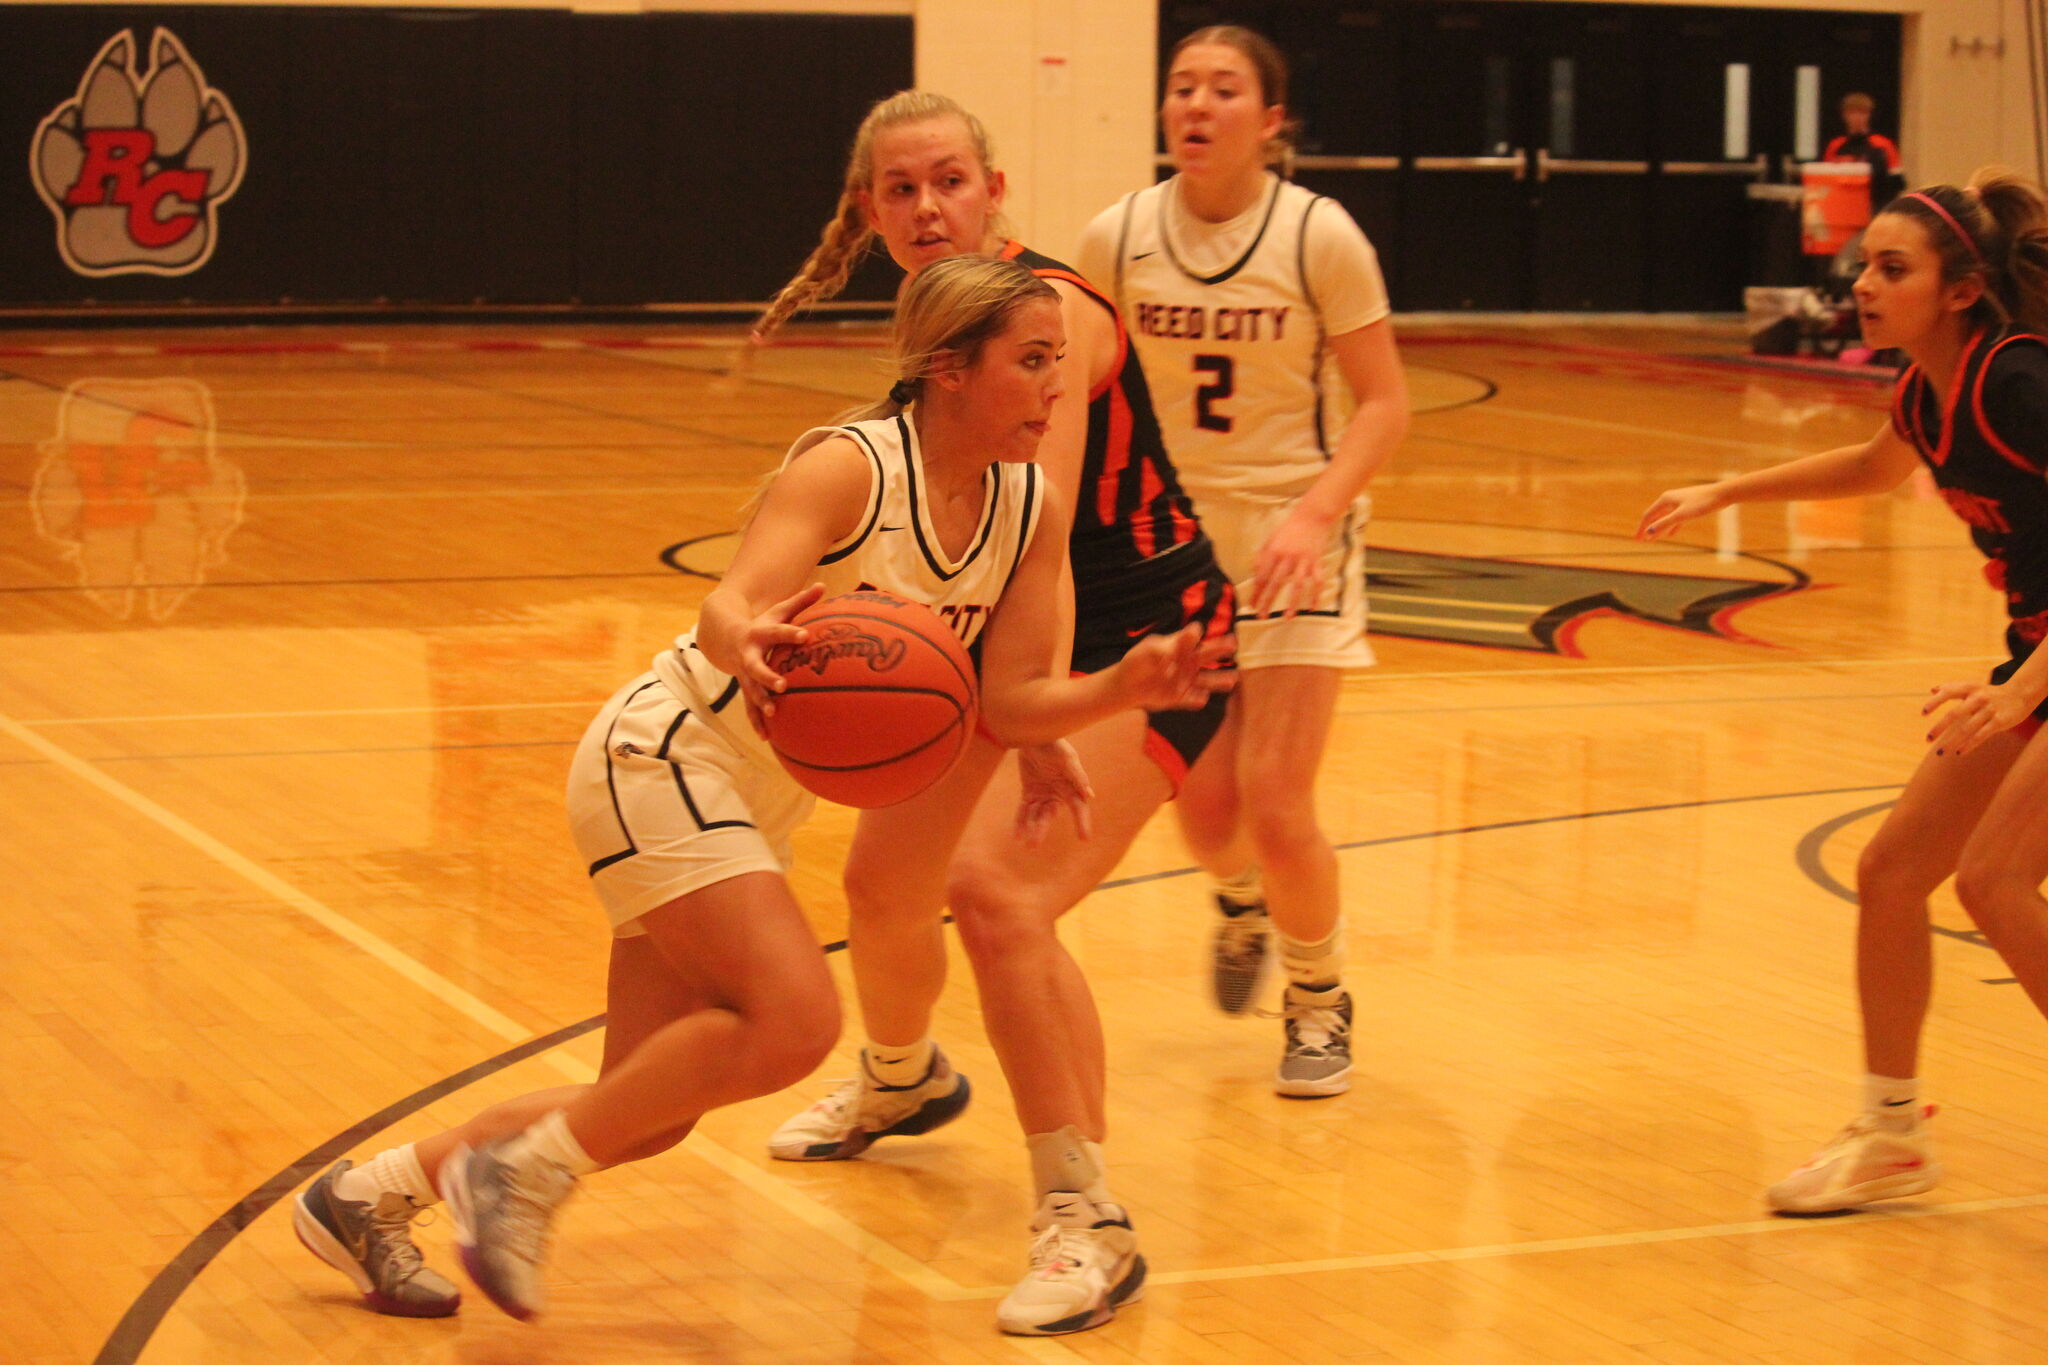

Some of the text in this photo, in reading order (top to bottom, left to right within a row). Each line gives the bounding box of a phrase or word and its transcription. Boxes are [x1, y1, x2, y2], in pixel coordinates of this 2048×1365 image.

[66, 129, 210, 248] RC
[1137, 303, 1291, 342] REED CITY
[1193, 354, 1235, 434] 2
